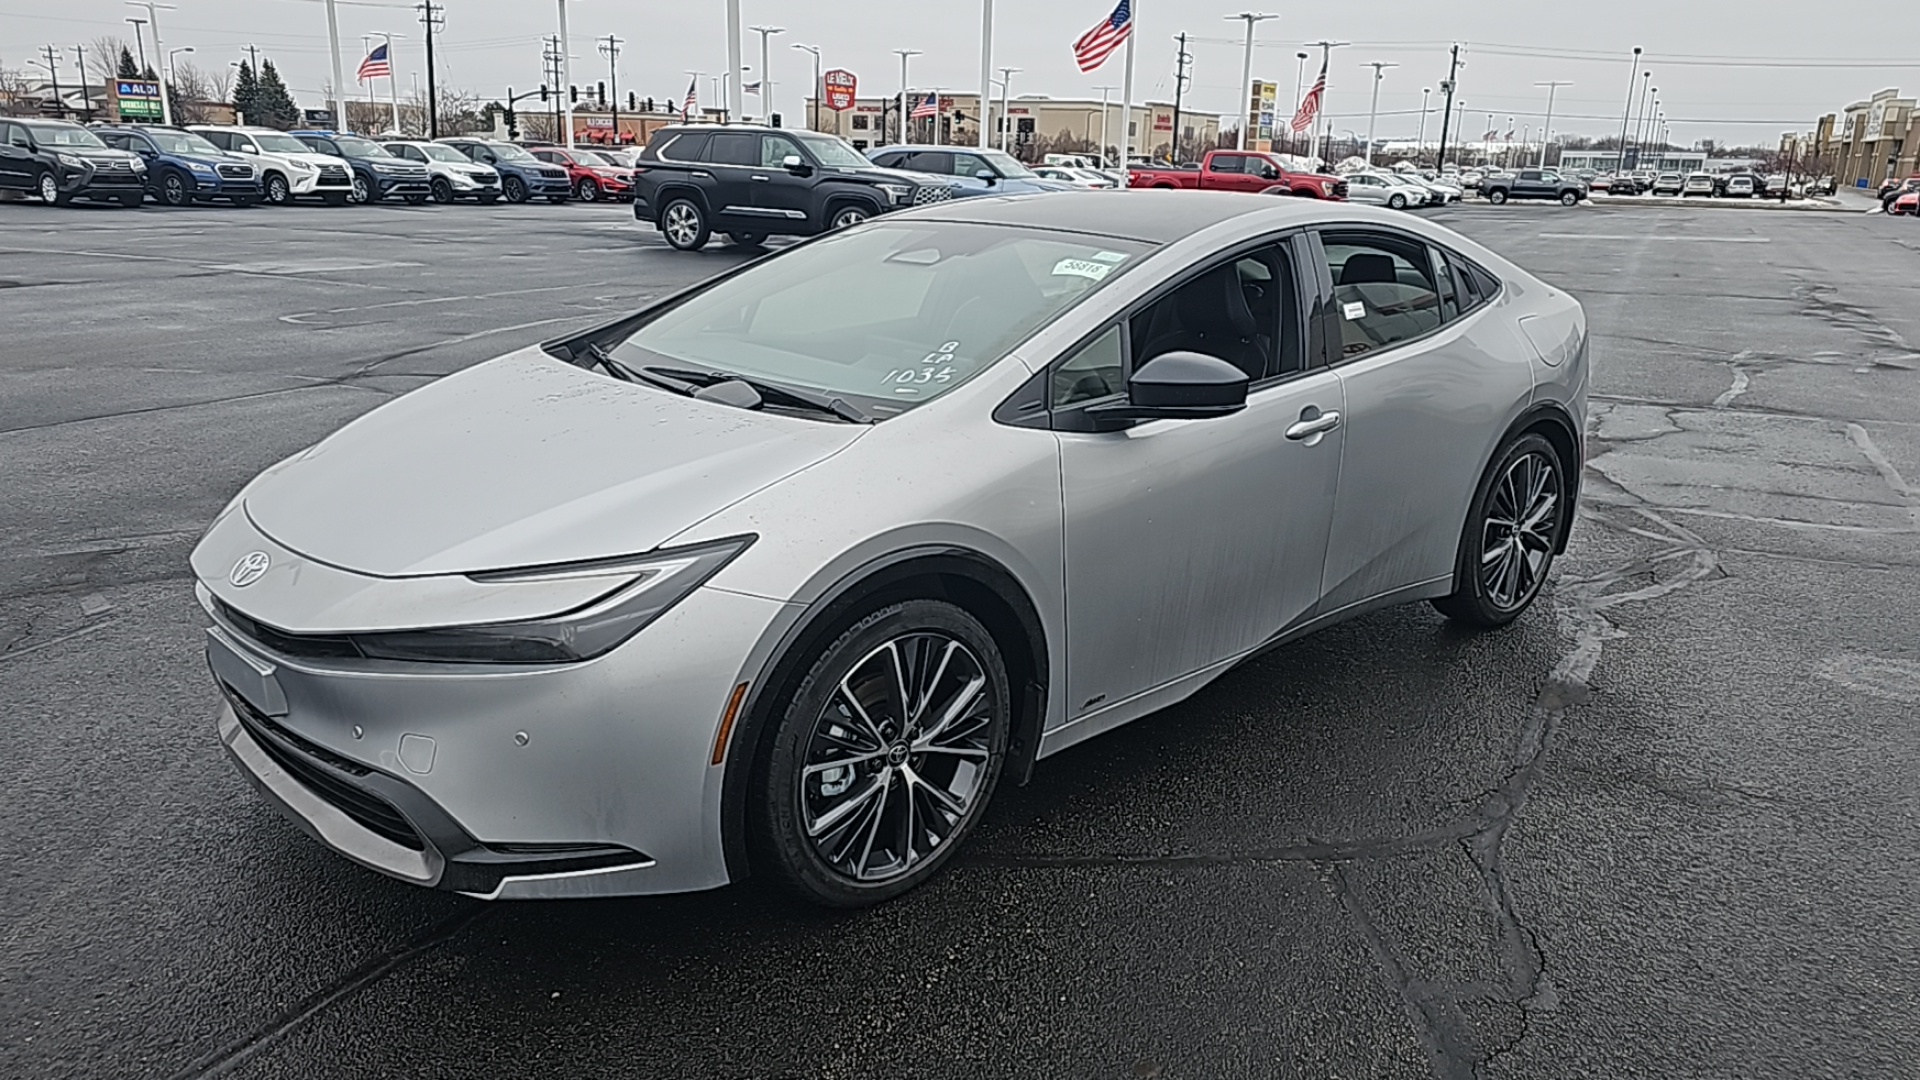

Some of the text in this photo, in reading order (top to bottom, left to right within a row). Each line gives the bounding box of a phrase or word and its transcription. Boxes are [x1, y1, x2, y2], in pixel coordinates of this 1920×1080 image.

[827, 73, 836, 84] LE
[132, 84, 158, 95] ALDI
[1064, 262, 1103, 273] 58818
[938, 341, 960, 353] B
[880, 366, 957, 385] 1035
